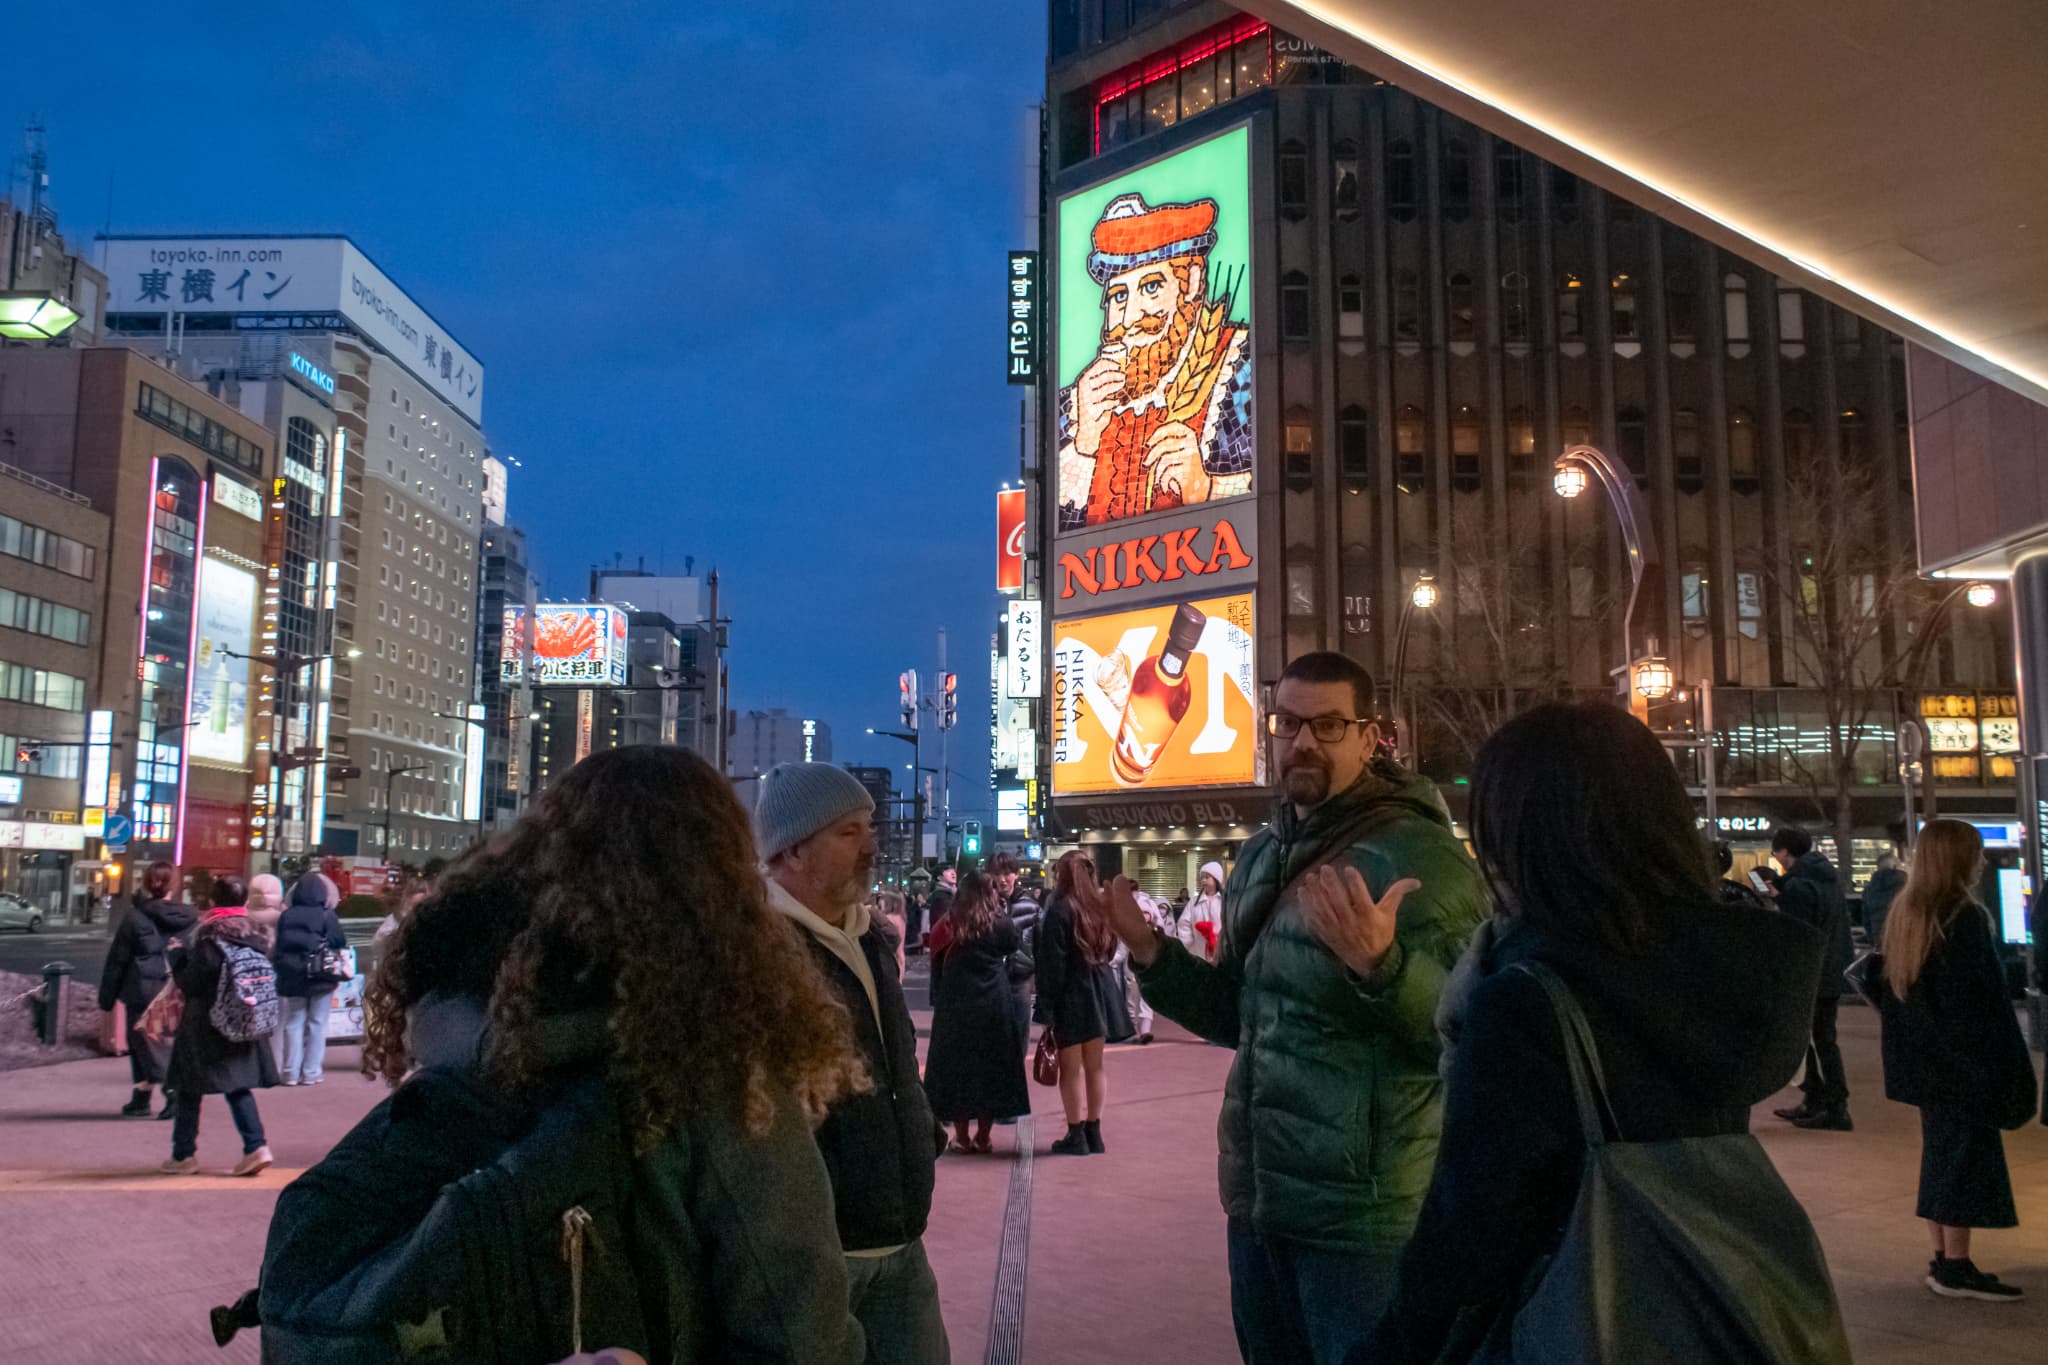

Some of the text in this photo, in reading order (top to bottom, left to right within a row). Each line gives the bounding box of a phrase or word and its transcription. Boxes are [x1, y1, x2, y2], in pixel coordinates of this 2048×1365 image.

[135, 267, 294, 304] 東横イン
[151, 248, 283, 266] toyoko-inn.com
[1010, 256, 1033, 375] すすきのビル
[291, 351, 335, 395] KITAKO
[422, 333, 478, 399] 東横イン
[1059, 519, 1253, 599] NIKKA
[1055, 651, 1068, 763] FRONTIER
[1071, 649, 1085, 723] NIKKA
[1087, 802, 1244, 826] SUSUKINO BLD.
